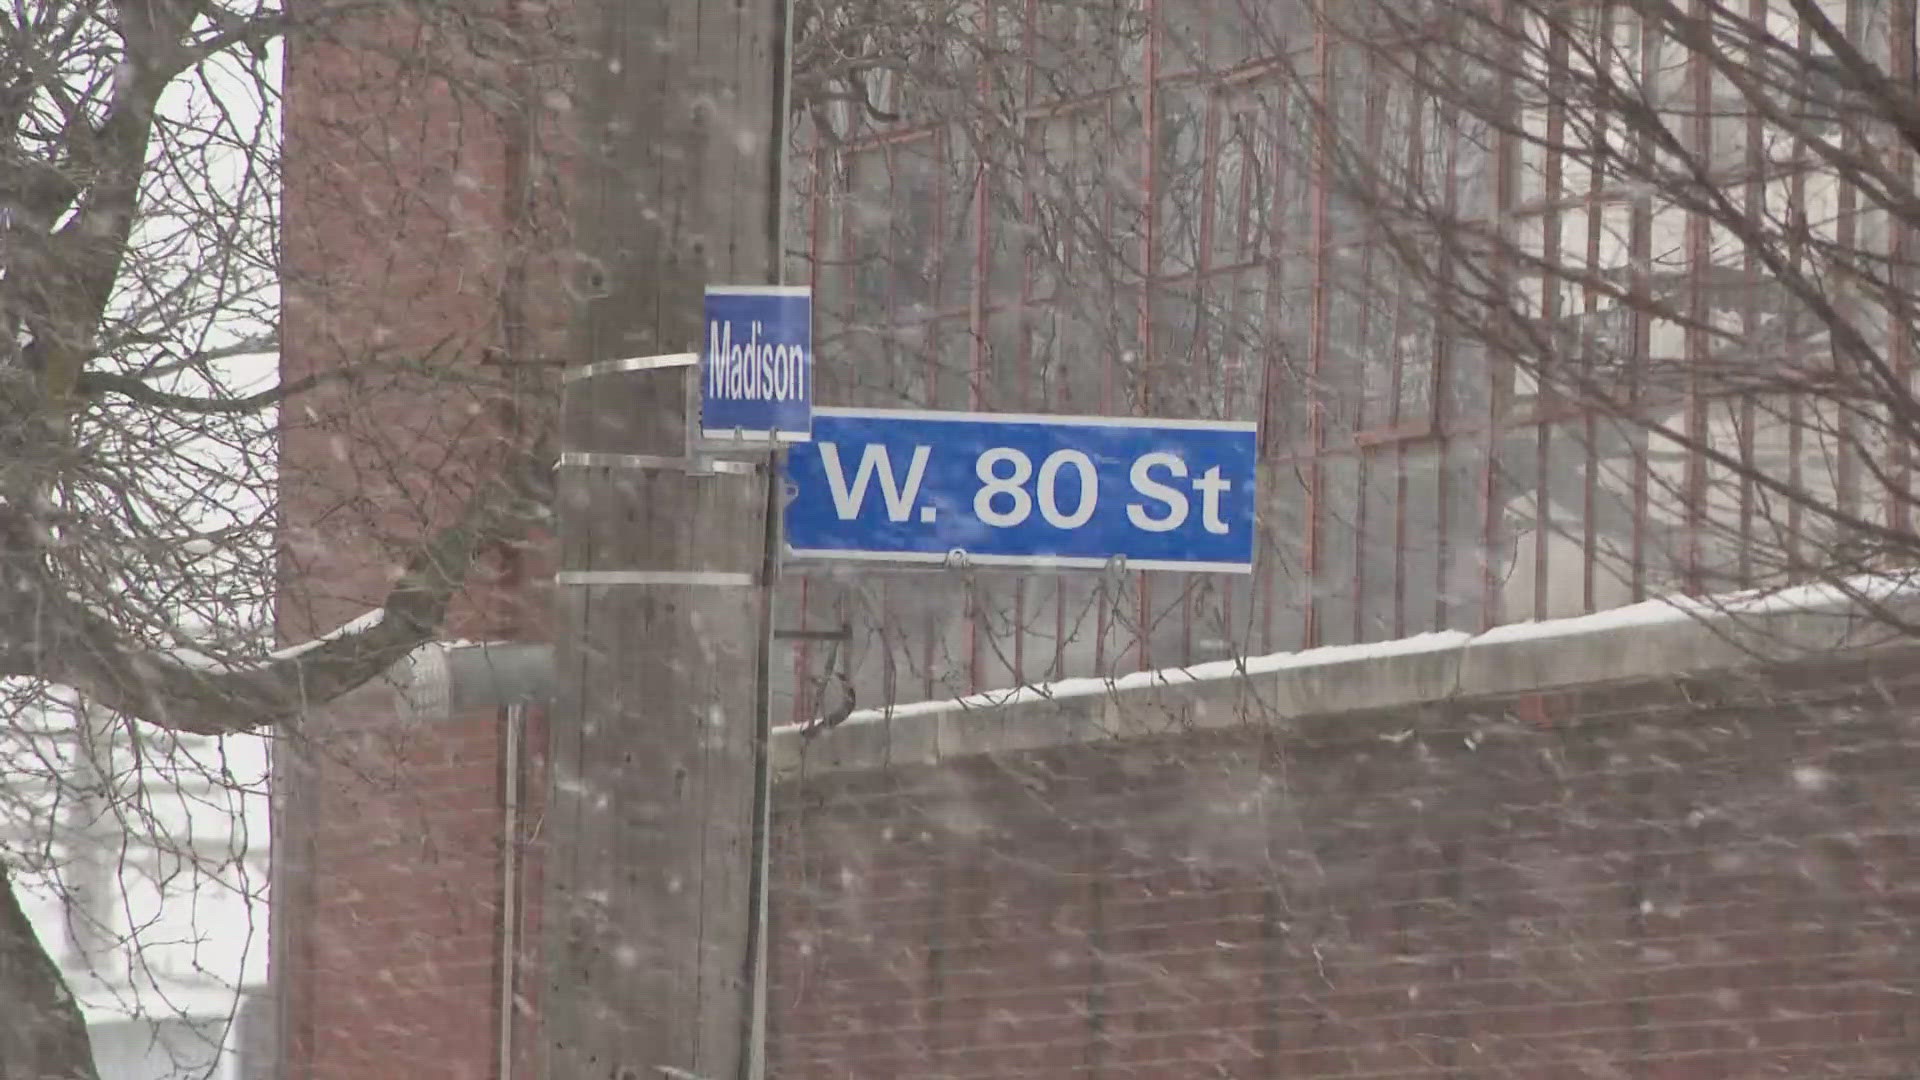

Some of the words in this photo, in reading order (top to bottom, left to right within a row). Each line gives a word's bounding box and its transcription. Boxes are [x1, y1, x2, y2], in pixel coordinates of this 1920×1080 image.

[709, 320, 804, 402] Madison
[818, 442, 937, 523] W.
[973, 447, 1099, 529] 80
[1125, 452, 1231, 534] St
